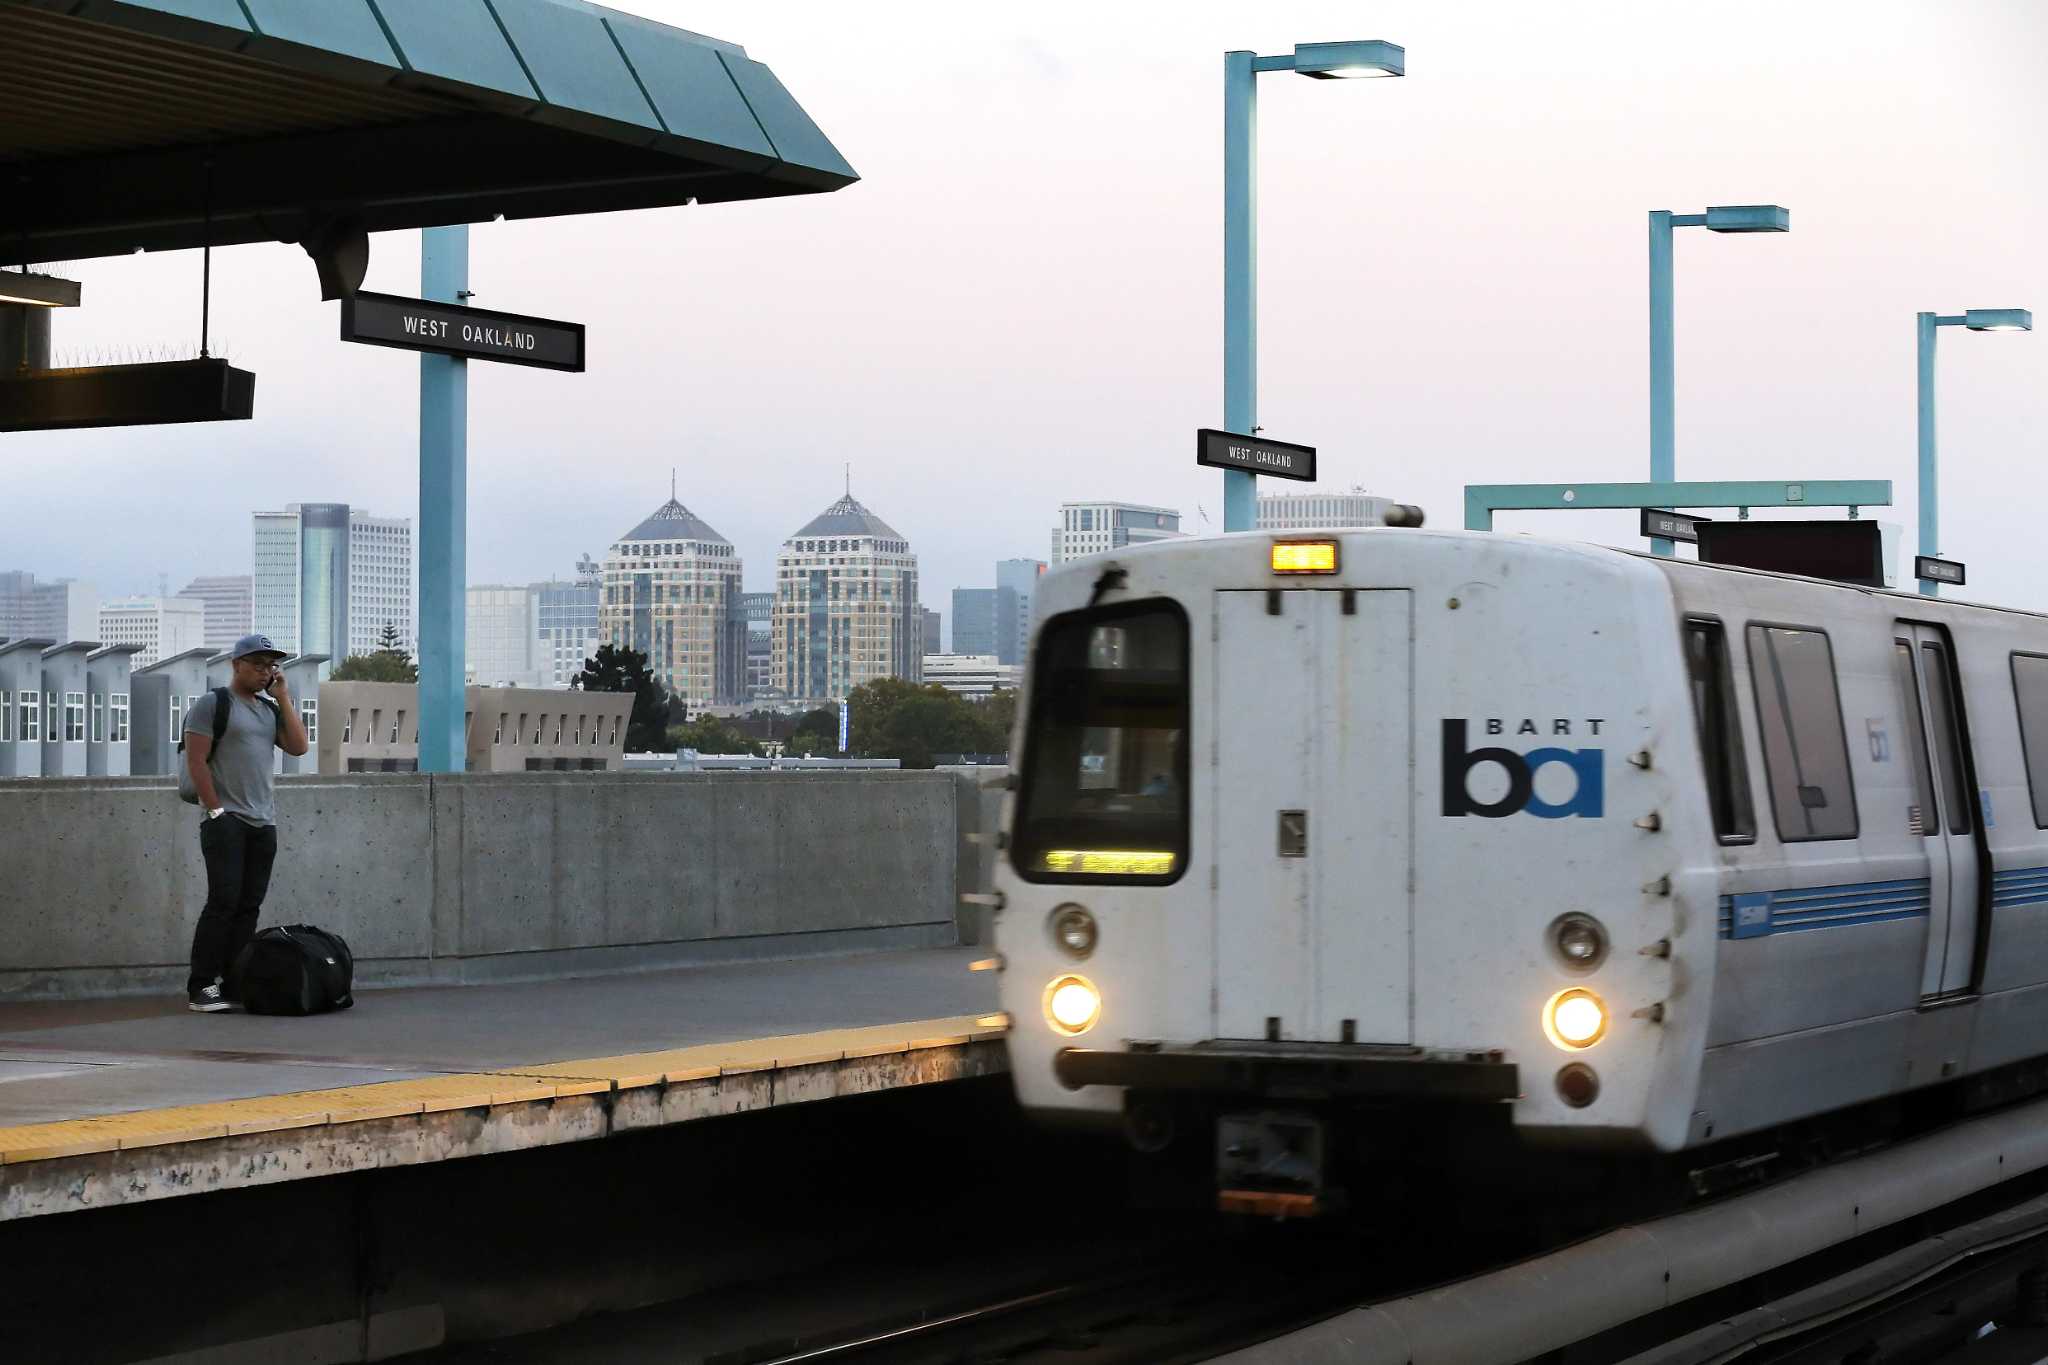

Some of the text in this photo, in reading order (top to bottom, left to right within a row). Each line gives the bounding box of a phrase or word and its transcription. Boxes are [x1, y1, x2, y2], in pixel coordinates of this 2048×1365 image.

[403, 316, 535, 350] WEST OAKLAND
[1229, 446, 1291, 468] WEST OAKLAND
[1486, 718, 1605, 735] BART
